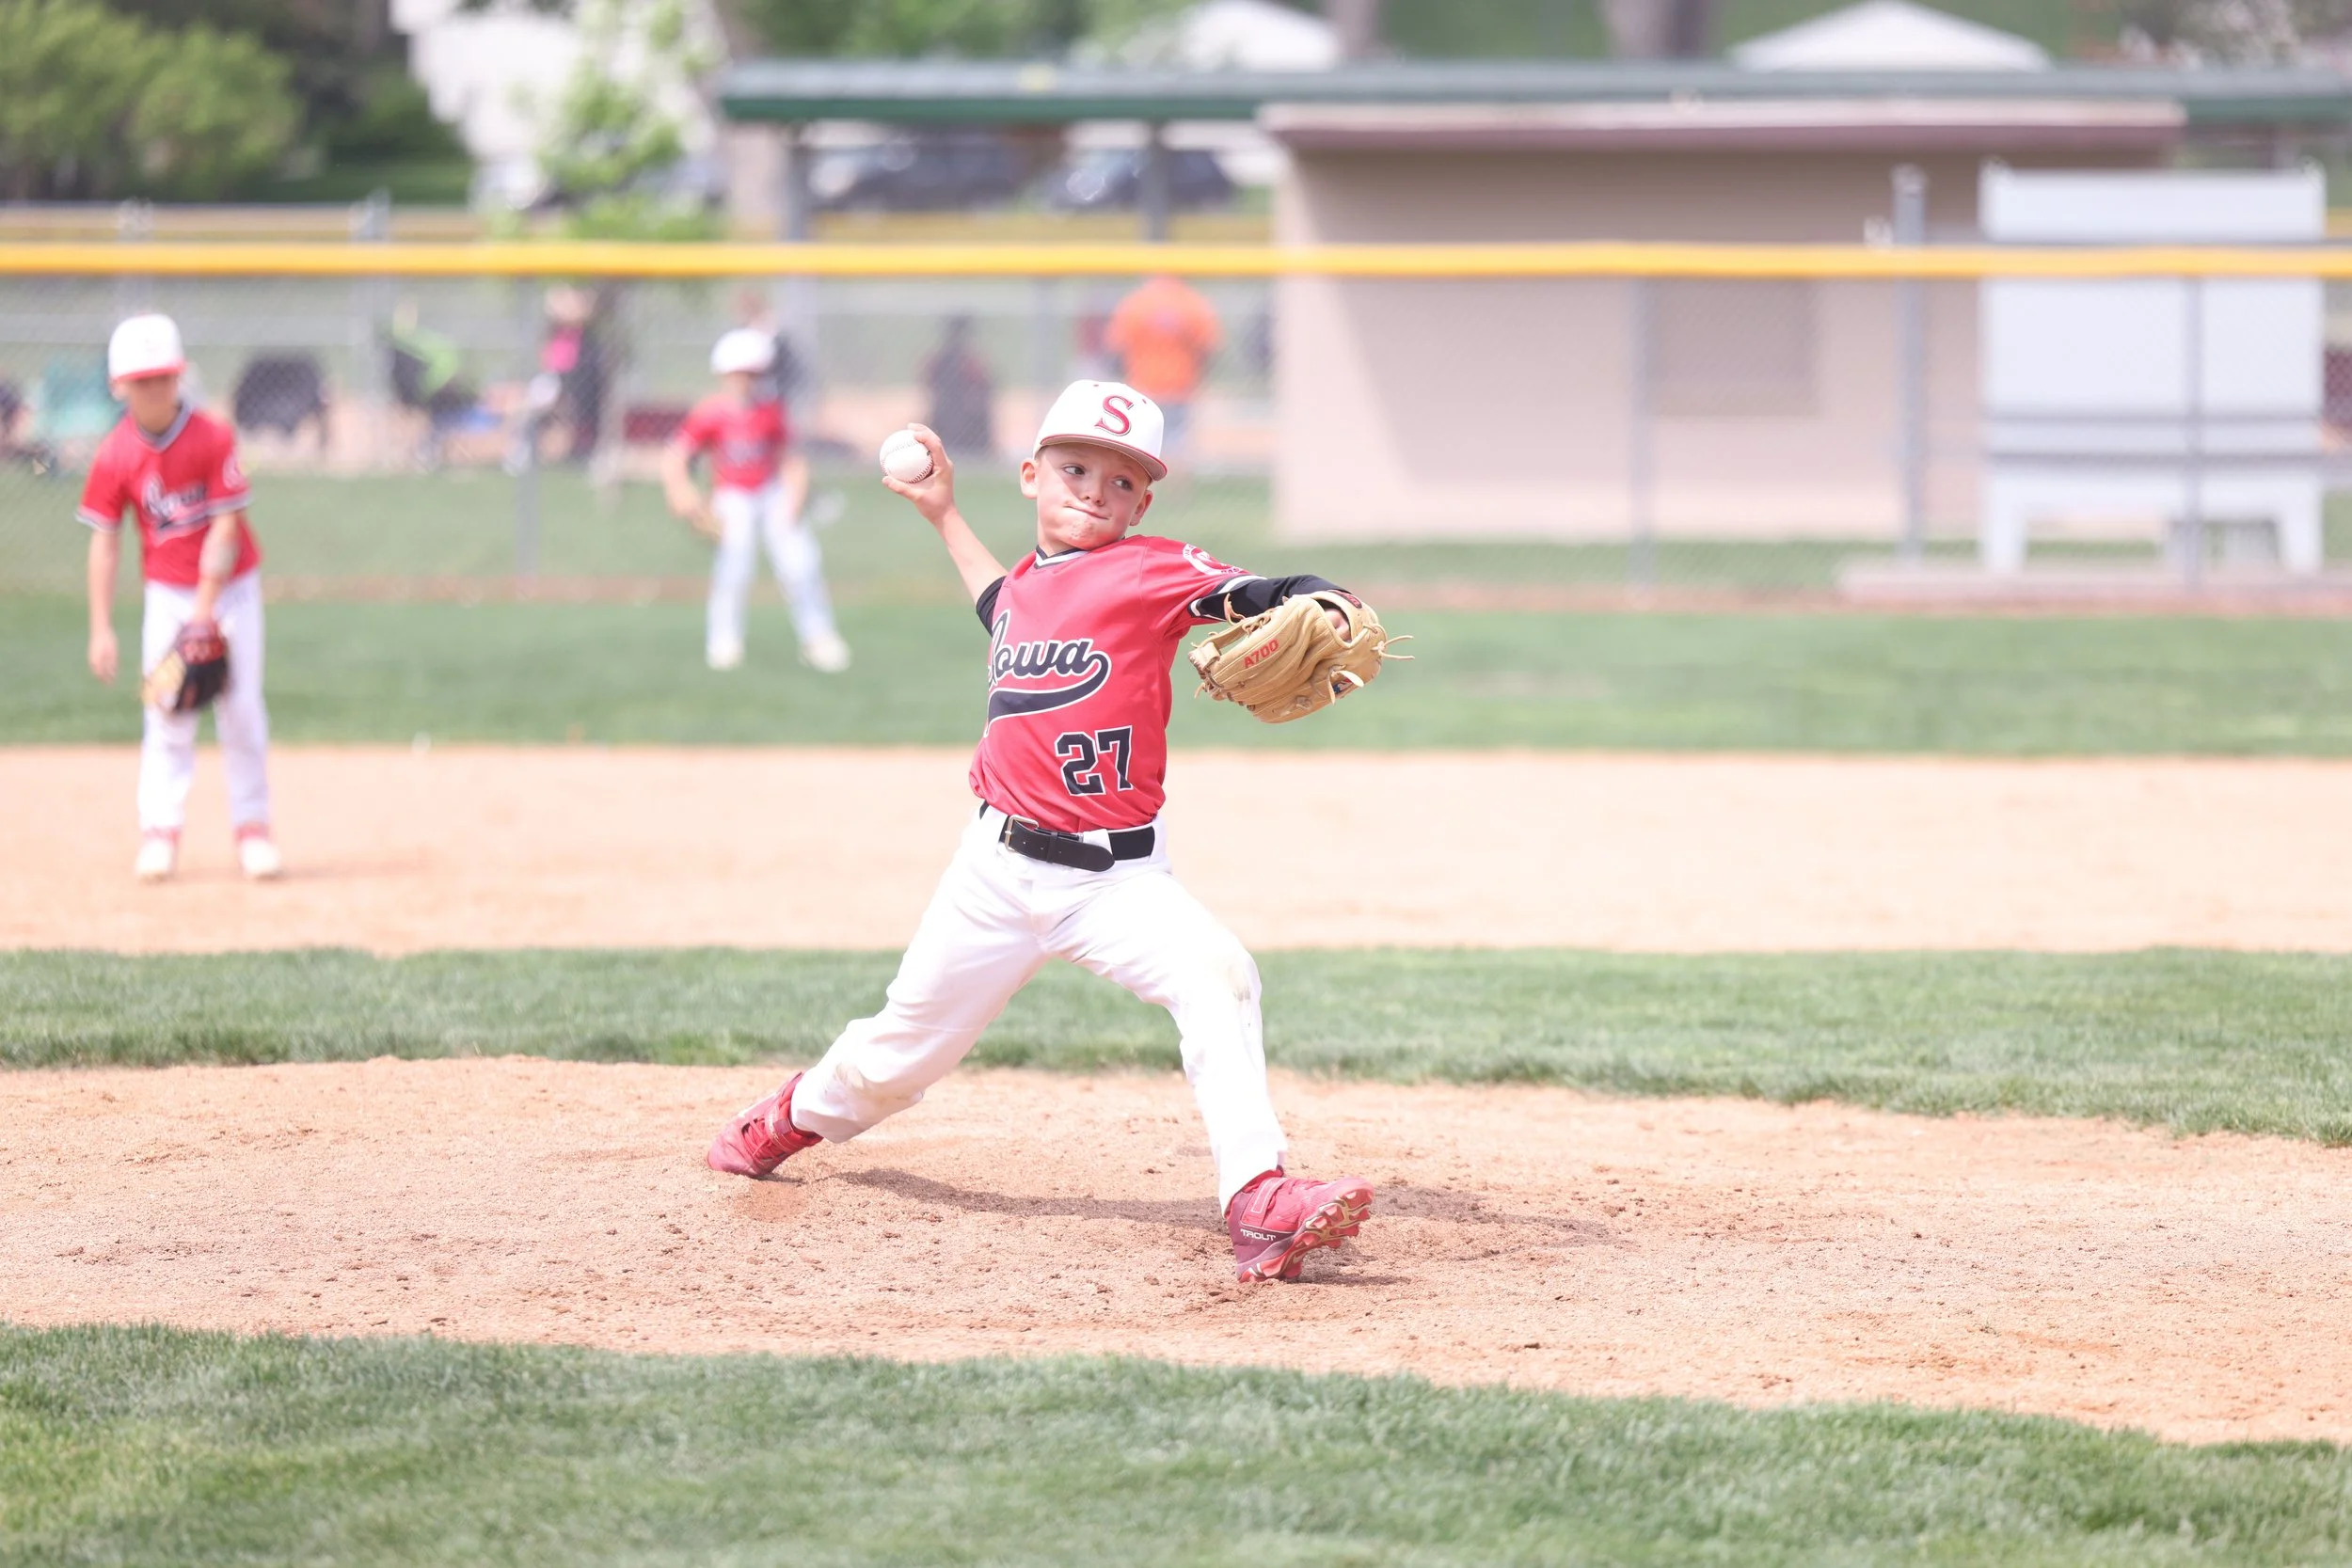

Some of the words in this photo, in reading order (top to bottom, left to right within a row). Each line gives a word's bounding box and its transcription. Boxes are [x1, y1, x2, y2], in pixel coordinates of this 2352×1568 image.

[1094, 395, 1134, 436] S
[1244, 639, 1279, 669] A700
[1054, 725, 1133, 796] 27
[1240, 1228, 1276, 1242] TROUT
